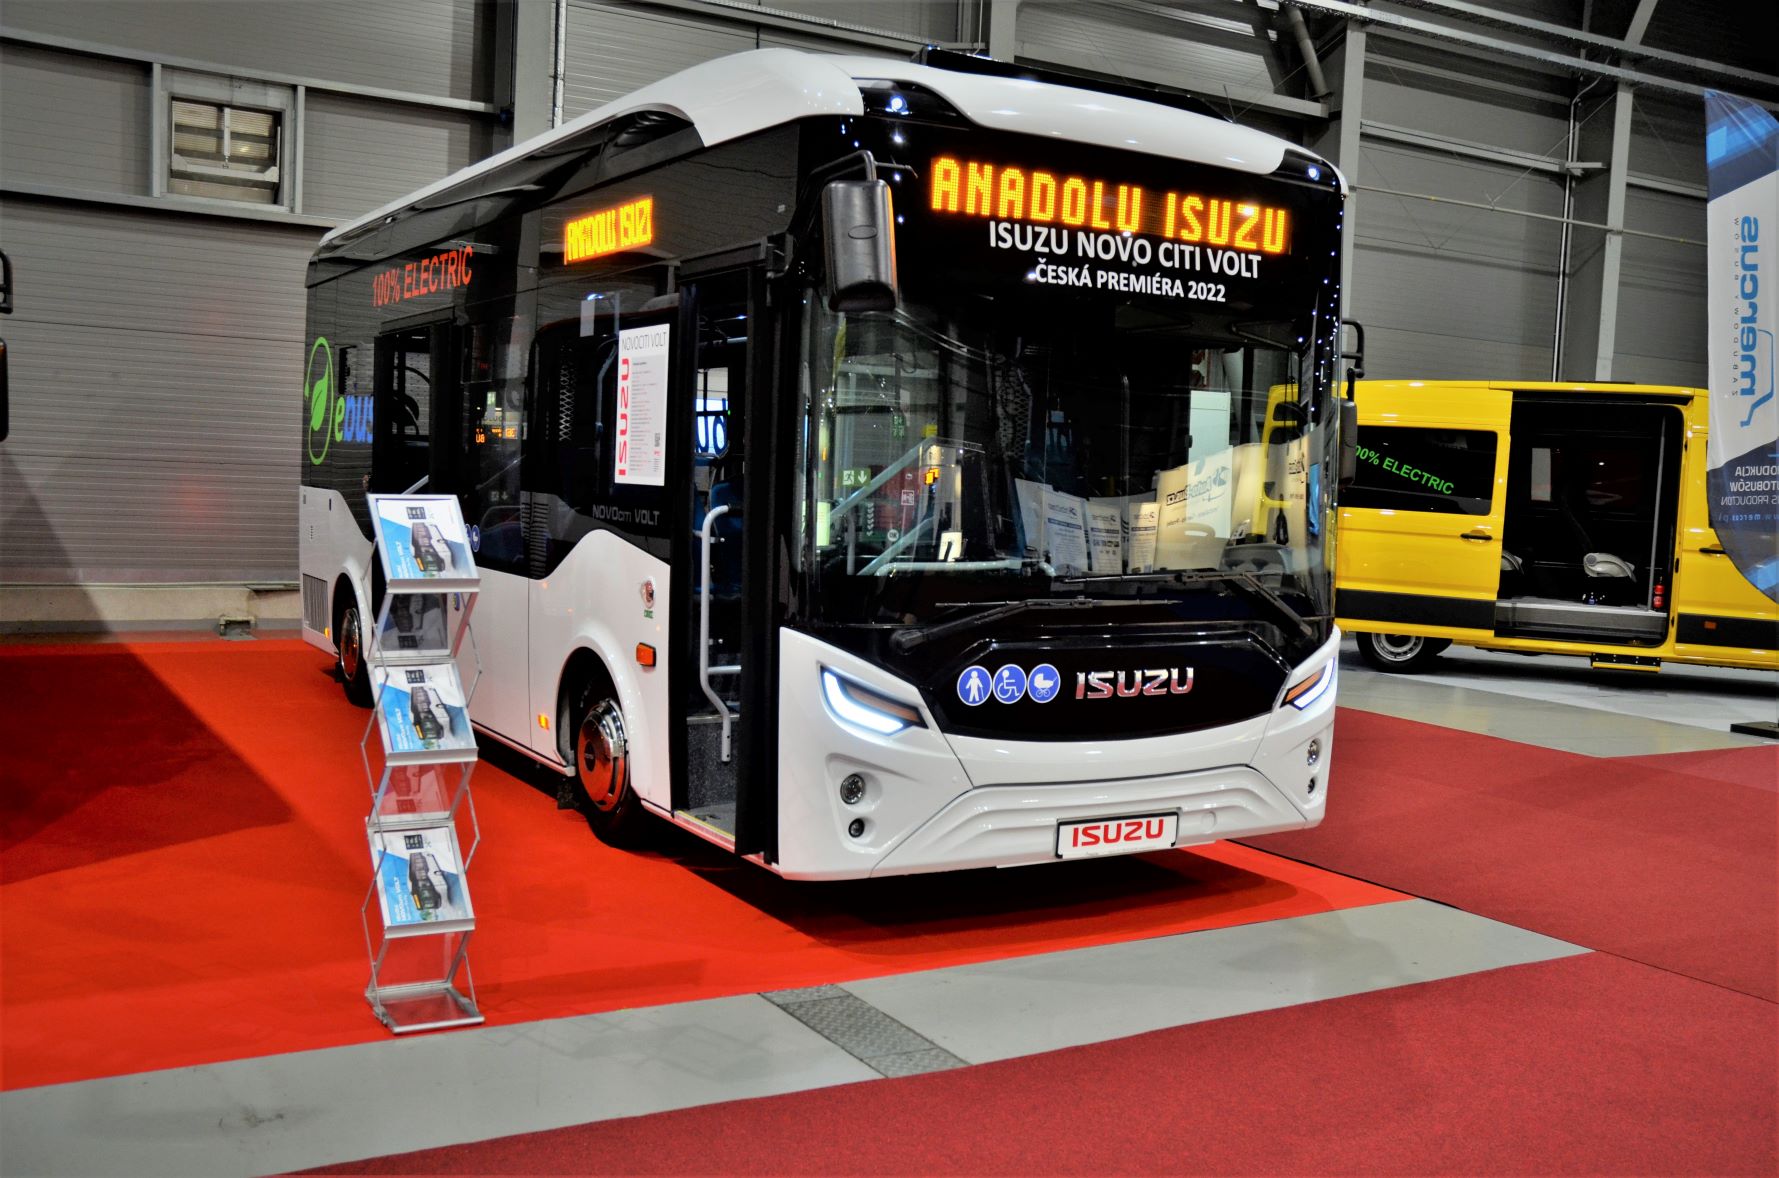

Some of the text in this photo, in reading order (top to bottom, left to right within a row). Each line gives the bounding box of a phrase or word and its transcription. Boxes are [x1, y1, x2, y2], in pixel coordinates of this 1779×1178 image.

[932, 158, 1287, 255] ANADOLU ISUZU
[372, 245, 472, 307] 100% ELECTRIC
[989, 221, 1262, 280] ISUZU NOVO CITI VOLT
[1036, 257, 1227, 303] ČESKÁ PREMIÉRA 2022
[618, 358, 629, 476] ISUZU
[1355, 444, 1455, 495] 00% ELECTRIC
[634, 508, 660, 526] VOLT
[1075, 666, 1194, 700] ISUZU
[1072, 819, 1164, 847] ISUZU
